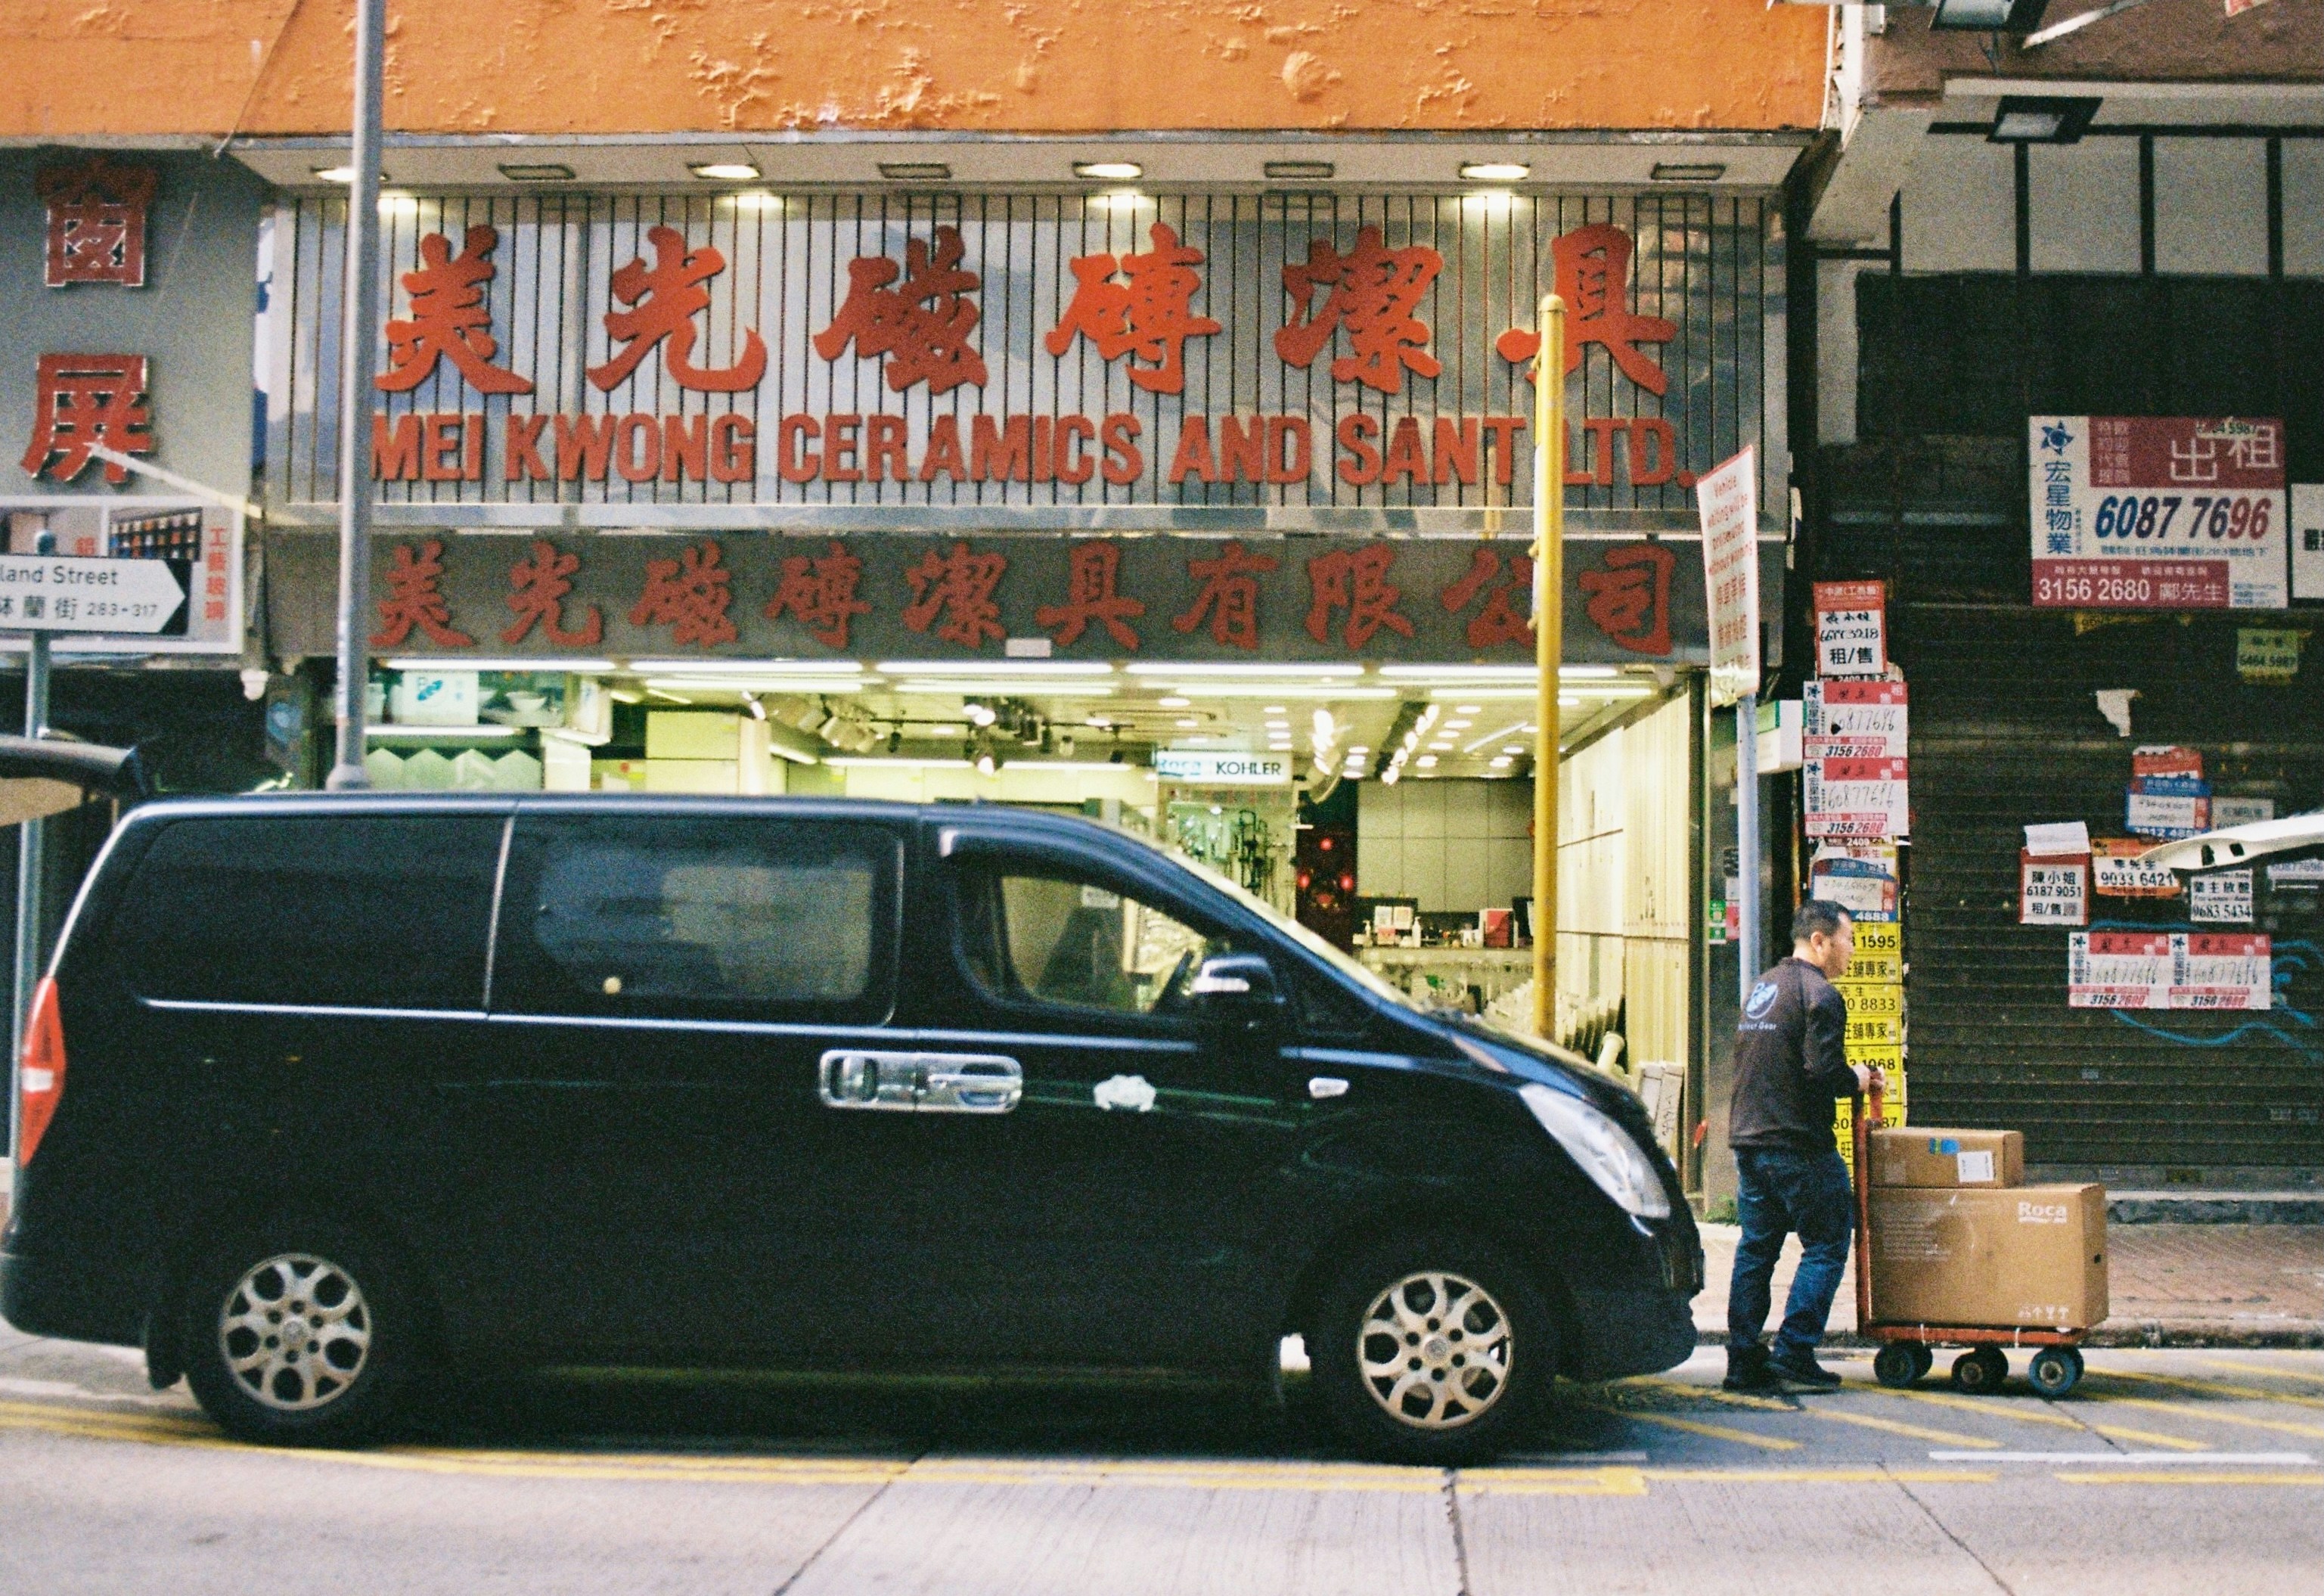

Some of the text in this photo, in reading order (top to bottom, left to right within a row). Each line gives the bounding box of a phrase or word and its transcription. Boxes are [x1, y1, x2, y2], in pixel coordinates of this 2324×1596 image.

[371, 413, 484, 482] MEI
[504, 413, 755, 483] KWONG
[778, 413, 1143, 485] CERAMICS
[1168, 415, 1312, 485] AND
[1337, 415, 1526, 486] SANT
[2170, 425, 2279, 480] 出租
[2045, 461, 2072, 554] 宏星物業
[2095, 495, 2183, 539] 6087
[2189, 497, 2272, 540] 7696
[53, 565, 119, 585] Street
[2039, 578, 2091, 601] 3156
[2097, 578, 2150, 601] 2680
[1829, 647, 1873, 665] 租/售
[1826, 746, 1853, 756] 3156
[1216, 762, 1281, 775] KOHLER
[1827, 823, 1854, 834] 3156
[2031, 871, 2076, 883] 陳小姐
[2101, 873, 2174, 886] 9033 6421
[2027, 886, 2081, 897] 6187 9051
[2031, 903, 2062, 915] 租/售
[2224, 905, 2251, 918] 5434
[1861, 936, 1896, 948] 1595
[1860, 998, 1896, 1011] 8833
[2090, 995, 2117, 1005] 3156
[2018, 1201, 2068, 1216] Roca
